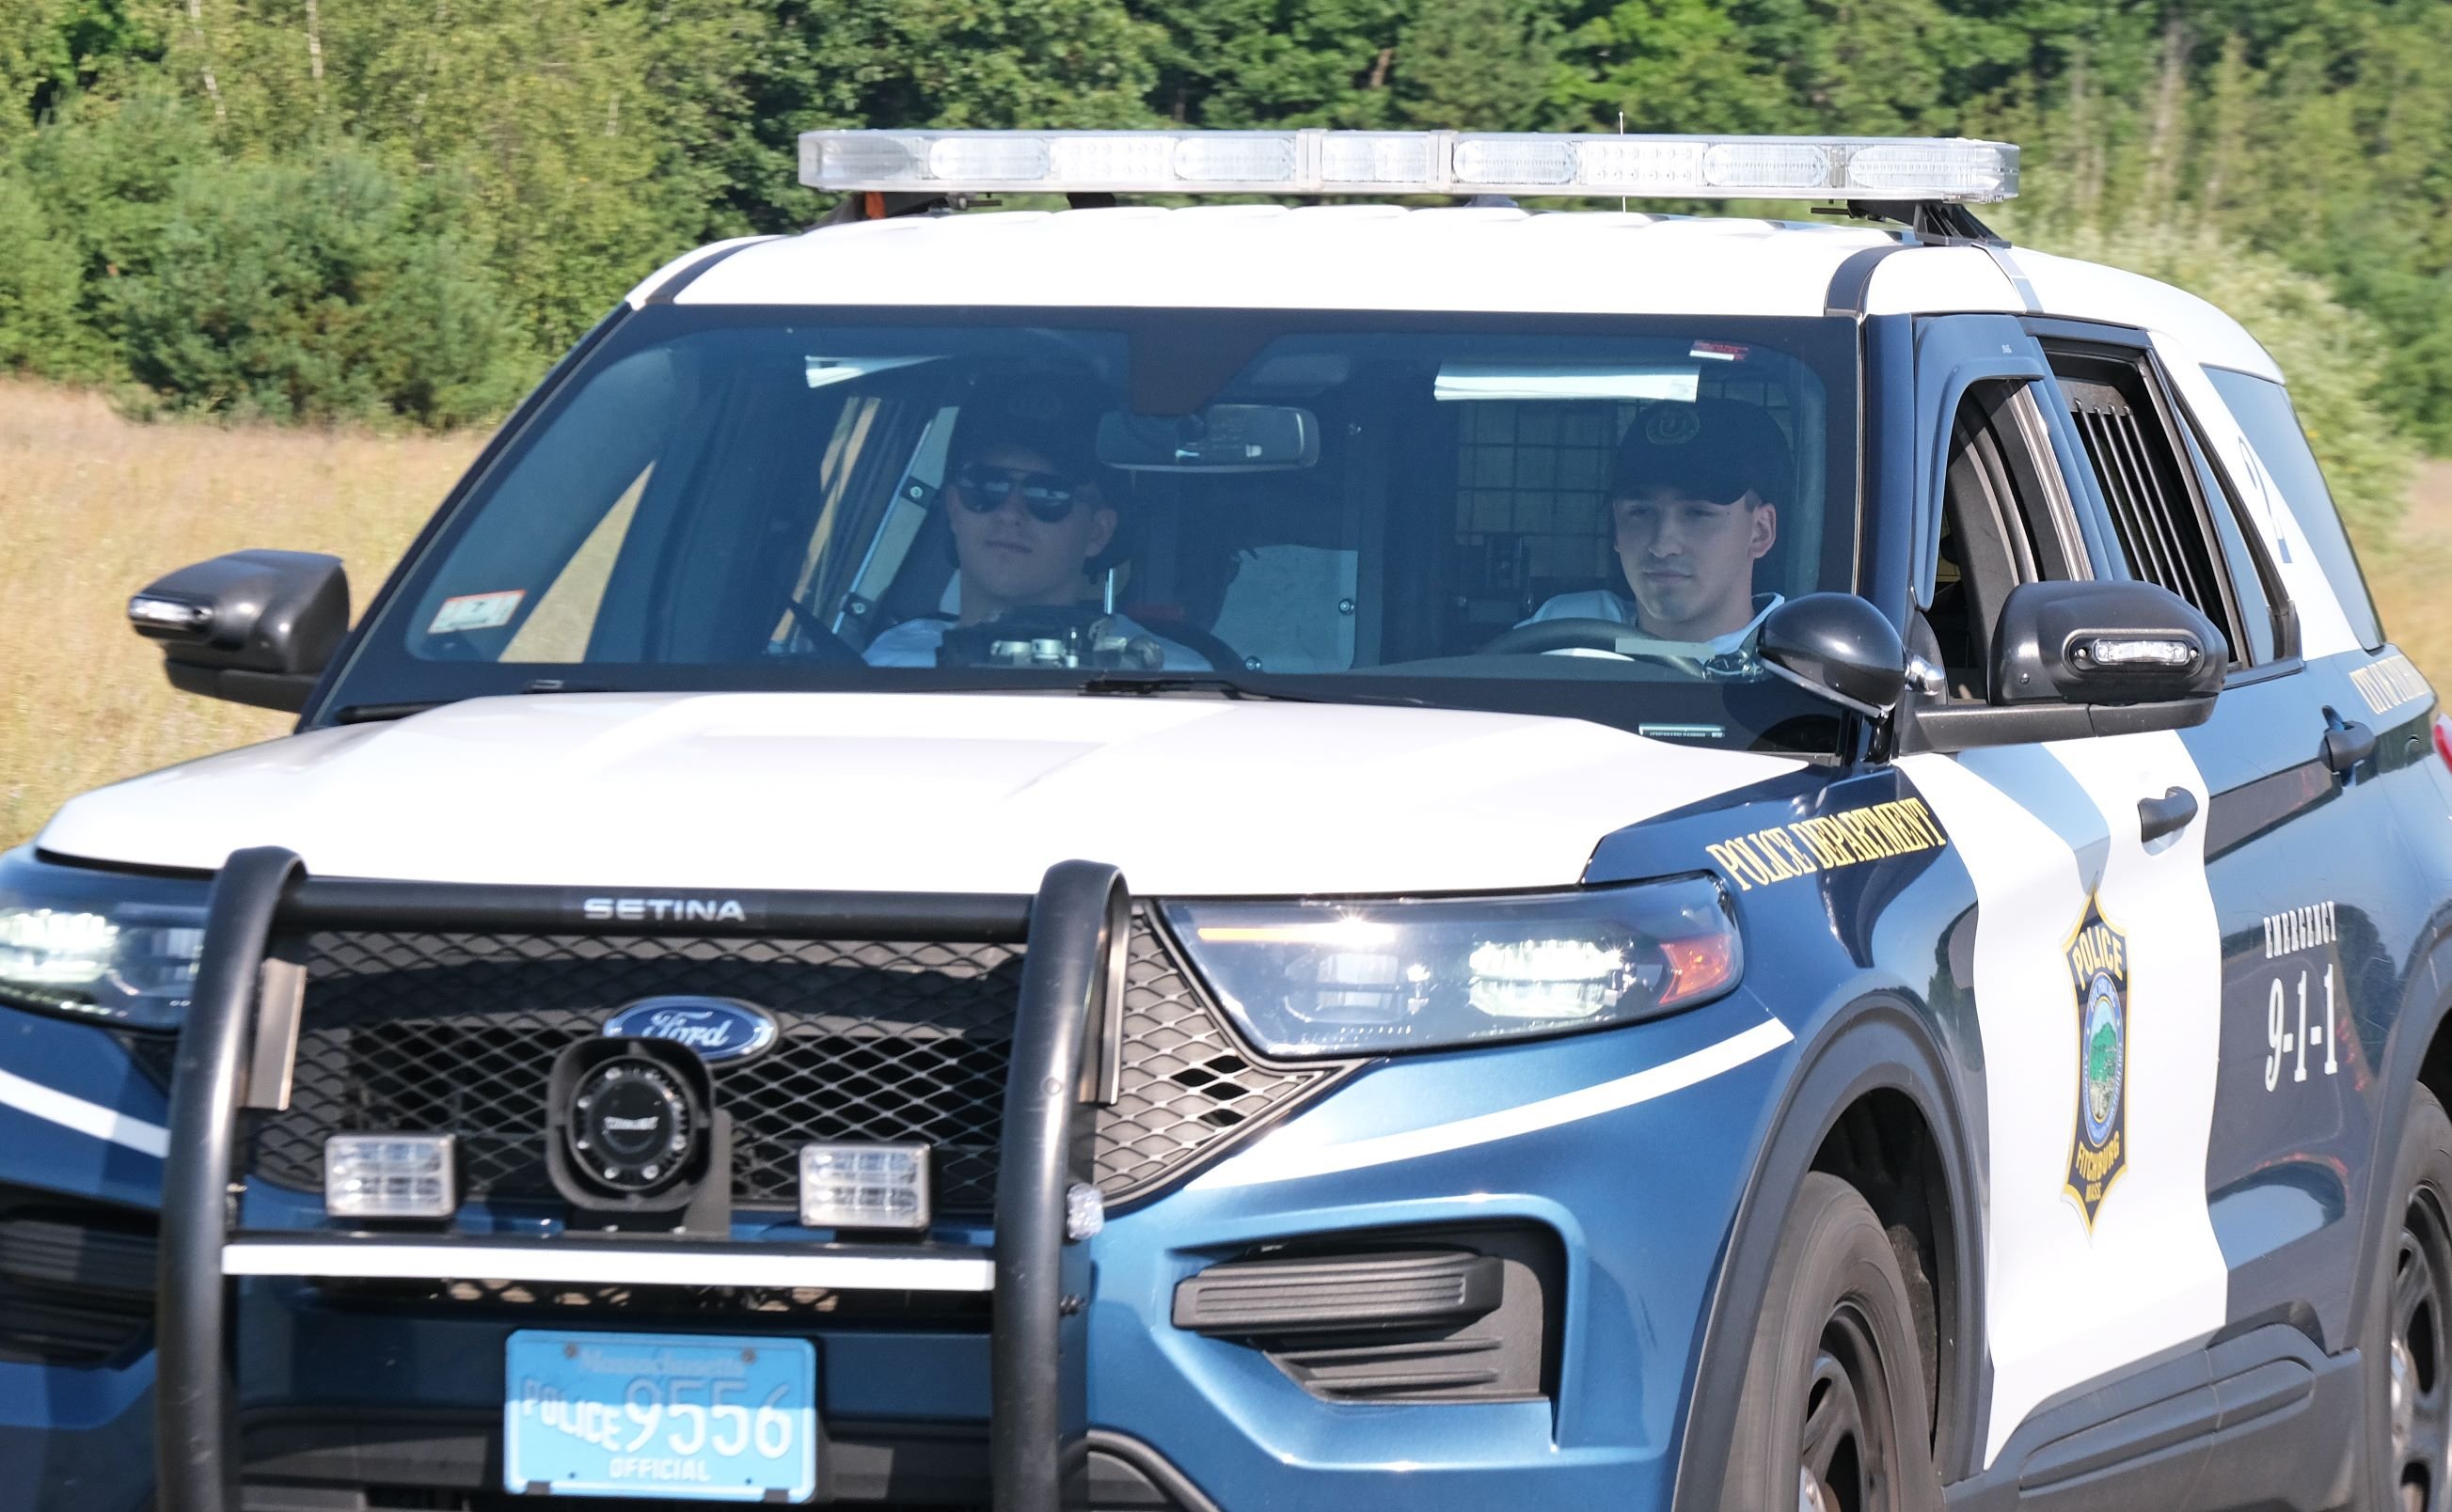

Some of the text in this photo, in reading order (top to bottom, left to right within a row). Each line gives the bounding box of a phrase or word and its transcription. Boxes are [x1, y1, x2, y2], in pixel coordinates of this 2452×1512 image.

[1706, 796, 1947, 891] POLICE DEPARTMENT
[583, 898, 747, 922] SETINA
[2072, 925, 2124, 992] POLICE
[641, 1011, 734, 1047] Ford
[2265, 963, 2338, 1093] 9-1-1
[2075, 1130, 2120, 1182] FITCHBURG
[521, 1377, 794, 1459] POLICE 9556
[609, 1457, 711, 1483] OFFICIAL
